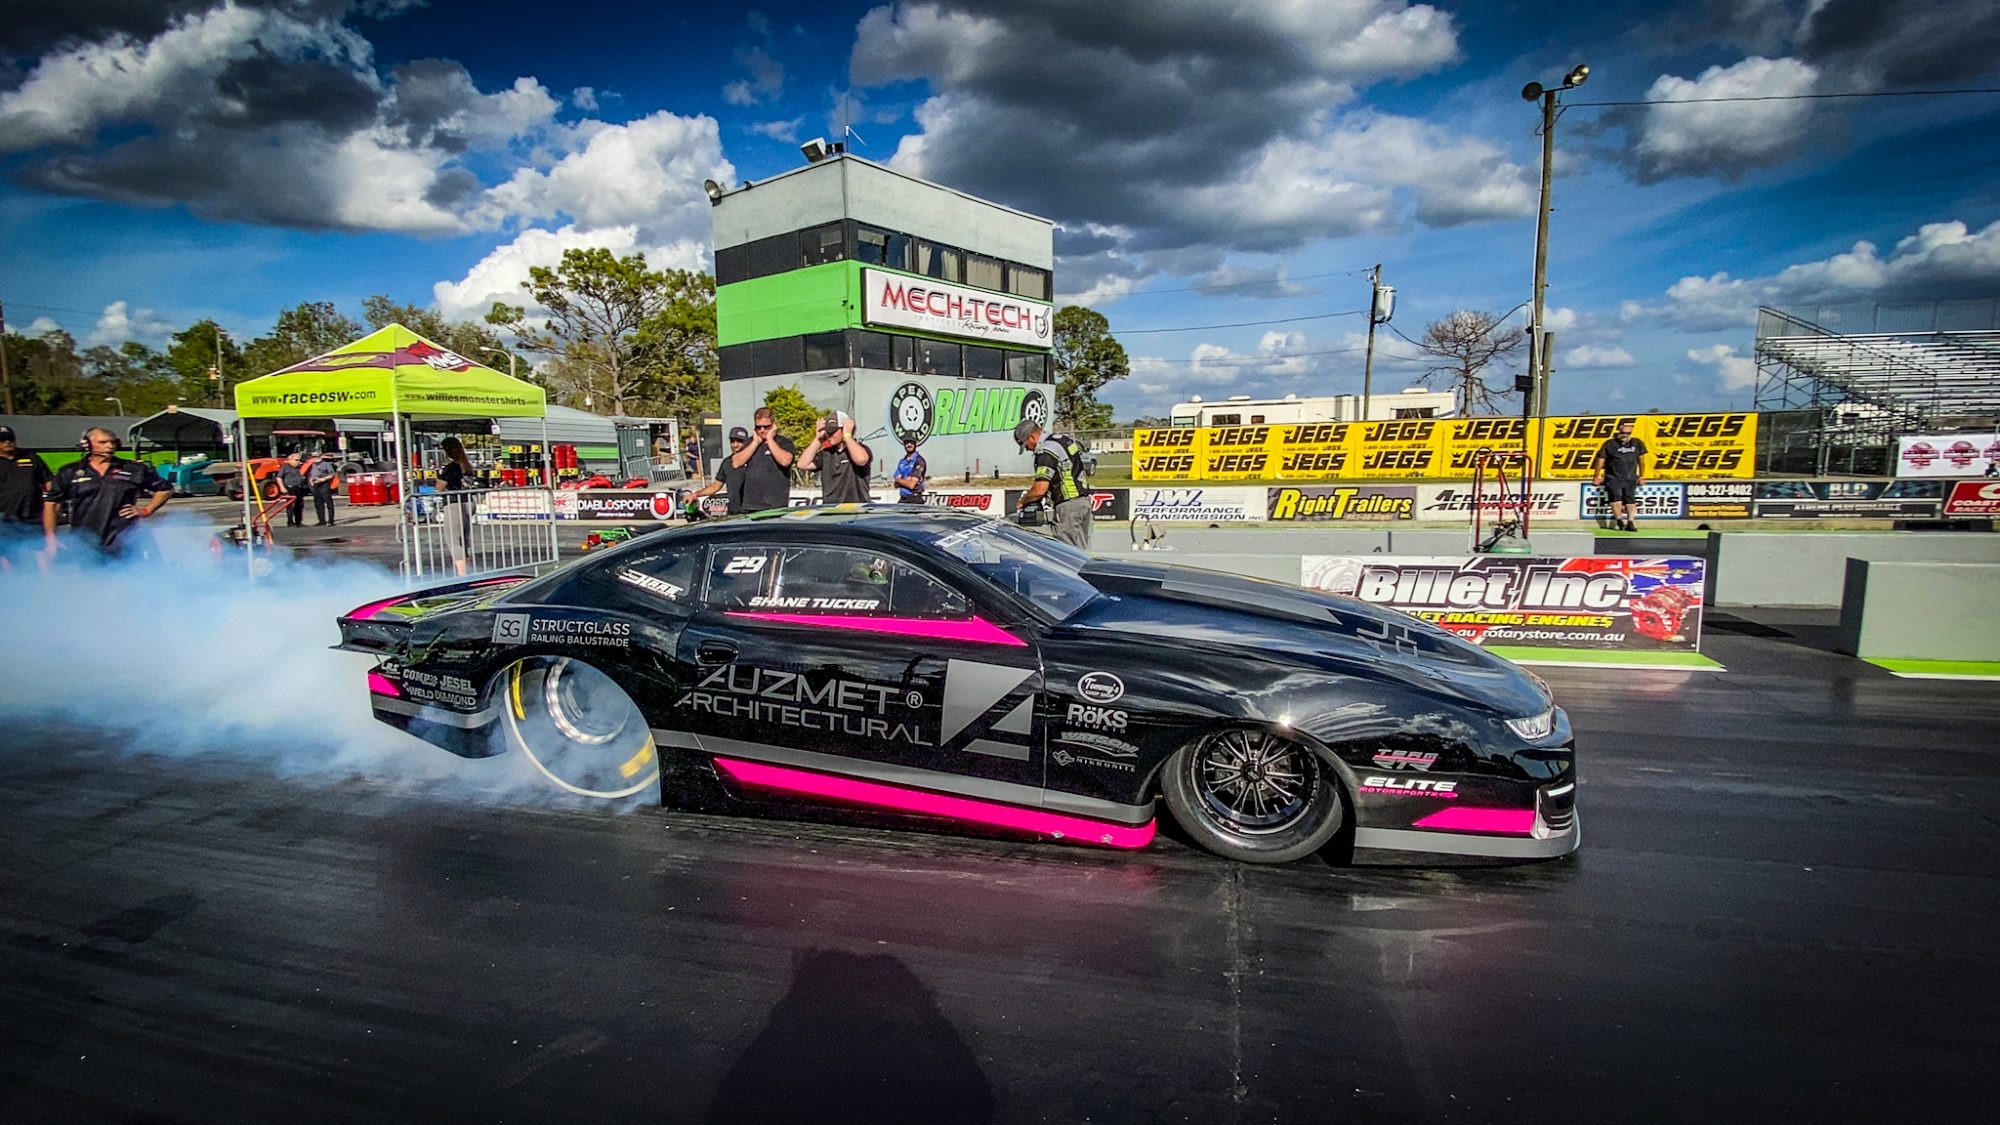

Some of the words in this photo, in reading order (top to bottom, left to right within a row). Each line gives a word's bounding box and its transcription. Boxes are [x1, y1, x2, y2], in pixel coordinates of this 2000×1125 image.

[881, 278, 1031, 330] MECH-TECH
[252, 391, 376, 404] www.raceosw.com
[893, 385, 930, 409] SPEED
[895, 423, 929, 441] WLD
[1283, 425, 1349, 443] JEGS
[1363, 422, 1435, 441] JEGS
[1453, 420, 1529, 440] JEGS
[1656, 416, 1746, 437] JEGS
[1140, 430, 1196, 447] JEGS
[1209, 427, 1270, 446] JEGS
[1140, 455, 1195, 472] JEGS
[1208, 454, 1269, 472] JEGS
[1282, 453, 1348, 470] JEGS
[1363, 451, 1433, 469] JEGS
[1451, 450, 1528, 469] JEGS
[1654, 449, 1743, 469] JEGS
[1135, 489, 1203, 507] J.W.
[1687, 485, 1752, 496] 800-327-9402
[1828, 483, 1869, 496] BLP
[578, 499, 650, 511] DIABLOSPORT
[1585, 496, 1679, 507] CHSSIS
[723, 556, 768, 573] 29
[1360, 569, 1512, 607] Billet
[1523, 571, 1631, 608] Inc.
[749, 596, 808, 608] SHANE
[811, 598, 880, 610] TUCKER
[500, 620, 520, 637] SG
[532, 619, 630, 635] STRUCTGLASS
[1446, 613, 1524, 626] RACING
[1526, 615, 1614, 627] ENGINES
[531, 633, 565, 643] RAILING
[567, 635, 629, 647] BALUSTRADE
[1482, 628, 1626, 642] rotarystore.com.au
[440, 675, 475, 690] JESEL
[1085, 677, 1119, 694] Tommy's
[408, 686, 434, 699] WELD
[434, 690, 476, 706] DIAMOND
[674, 691, 933, 747] ARCHITECTURAL
[1360, 786, 1440, 798] MOTORSPORTS
[1363, 776, 1457, 791] ELITE
